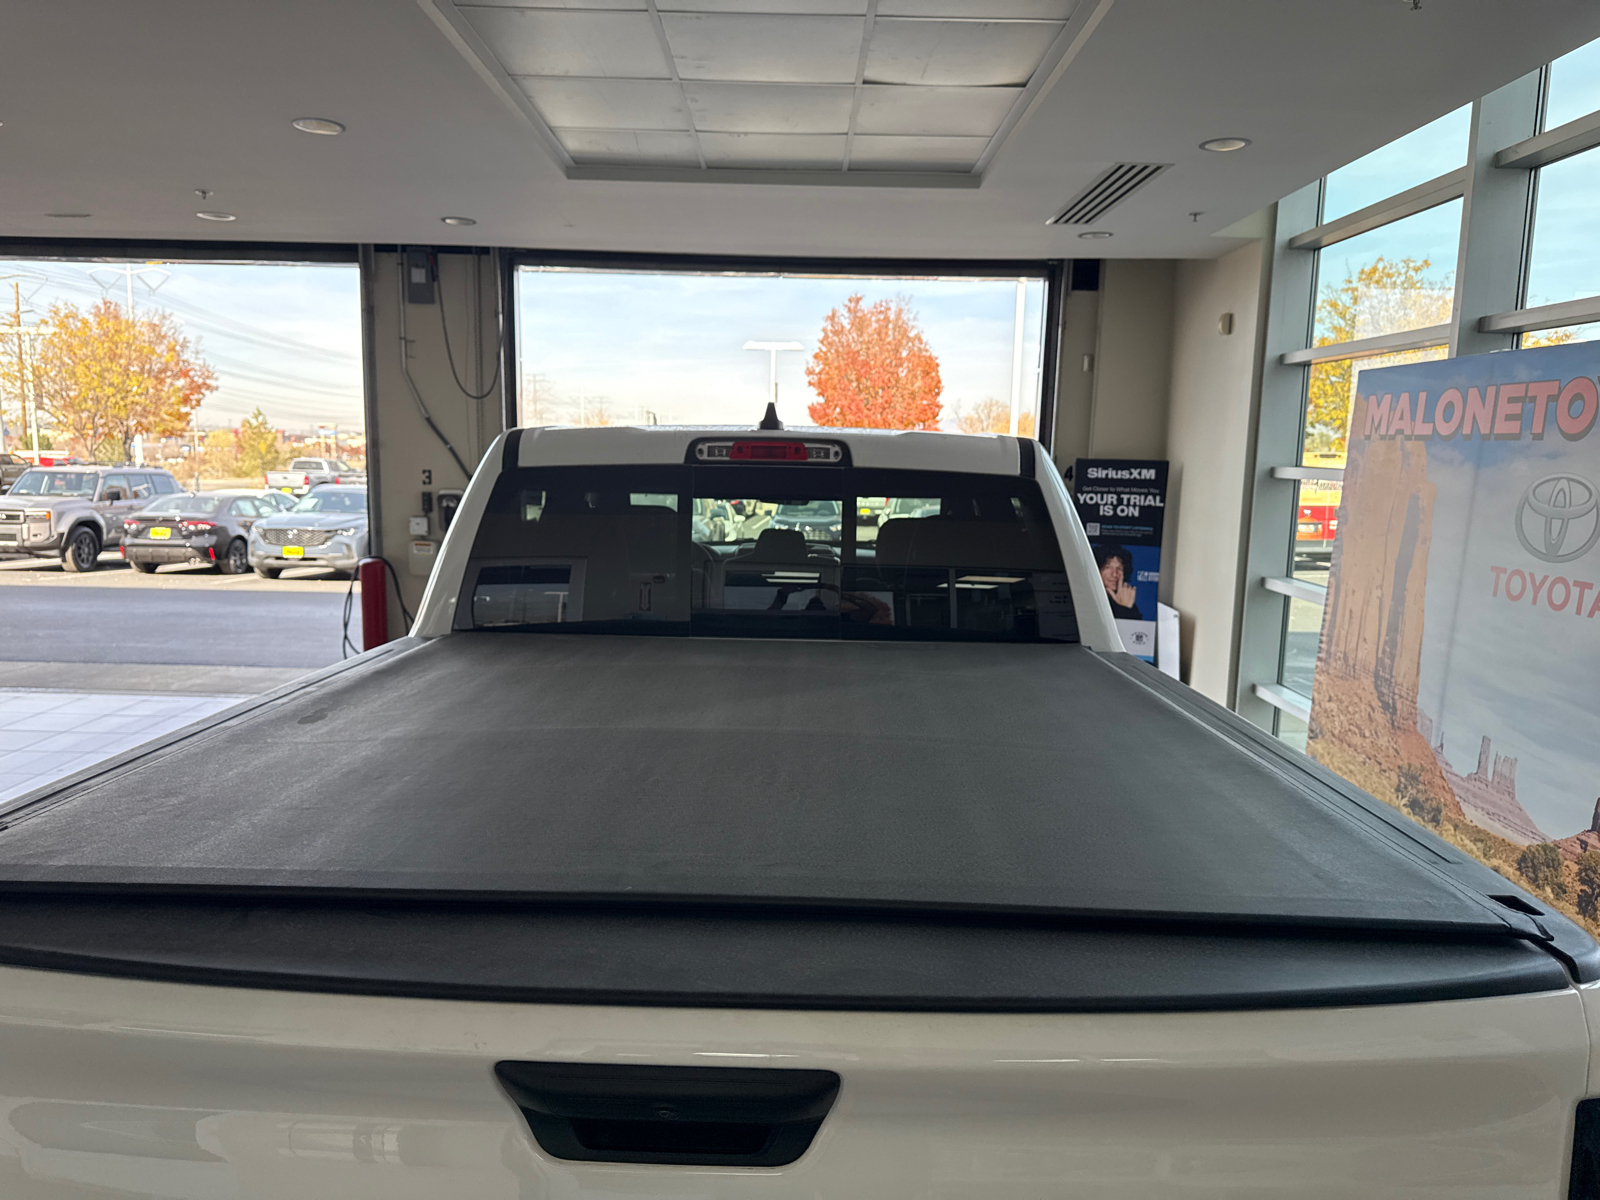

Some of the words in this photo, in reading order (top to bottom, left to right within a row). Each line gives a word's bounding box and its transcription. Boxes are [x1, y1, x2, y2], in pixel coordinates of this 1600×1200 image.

[1363, 375, 1600, 442] MALONETO
[422, 469, 432, 485] 3
[1064, 465, 1073, 481] 4
[1087, 467, 1156, 480] SiriusXM
[1077, 493, 1117, 505] YOUR
[1121, 494, 1164, 506] TRIAL
[1099, 505, 1113, 516] IS
[1117, 506, 1139, 517] ON
